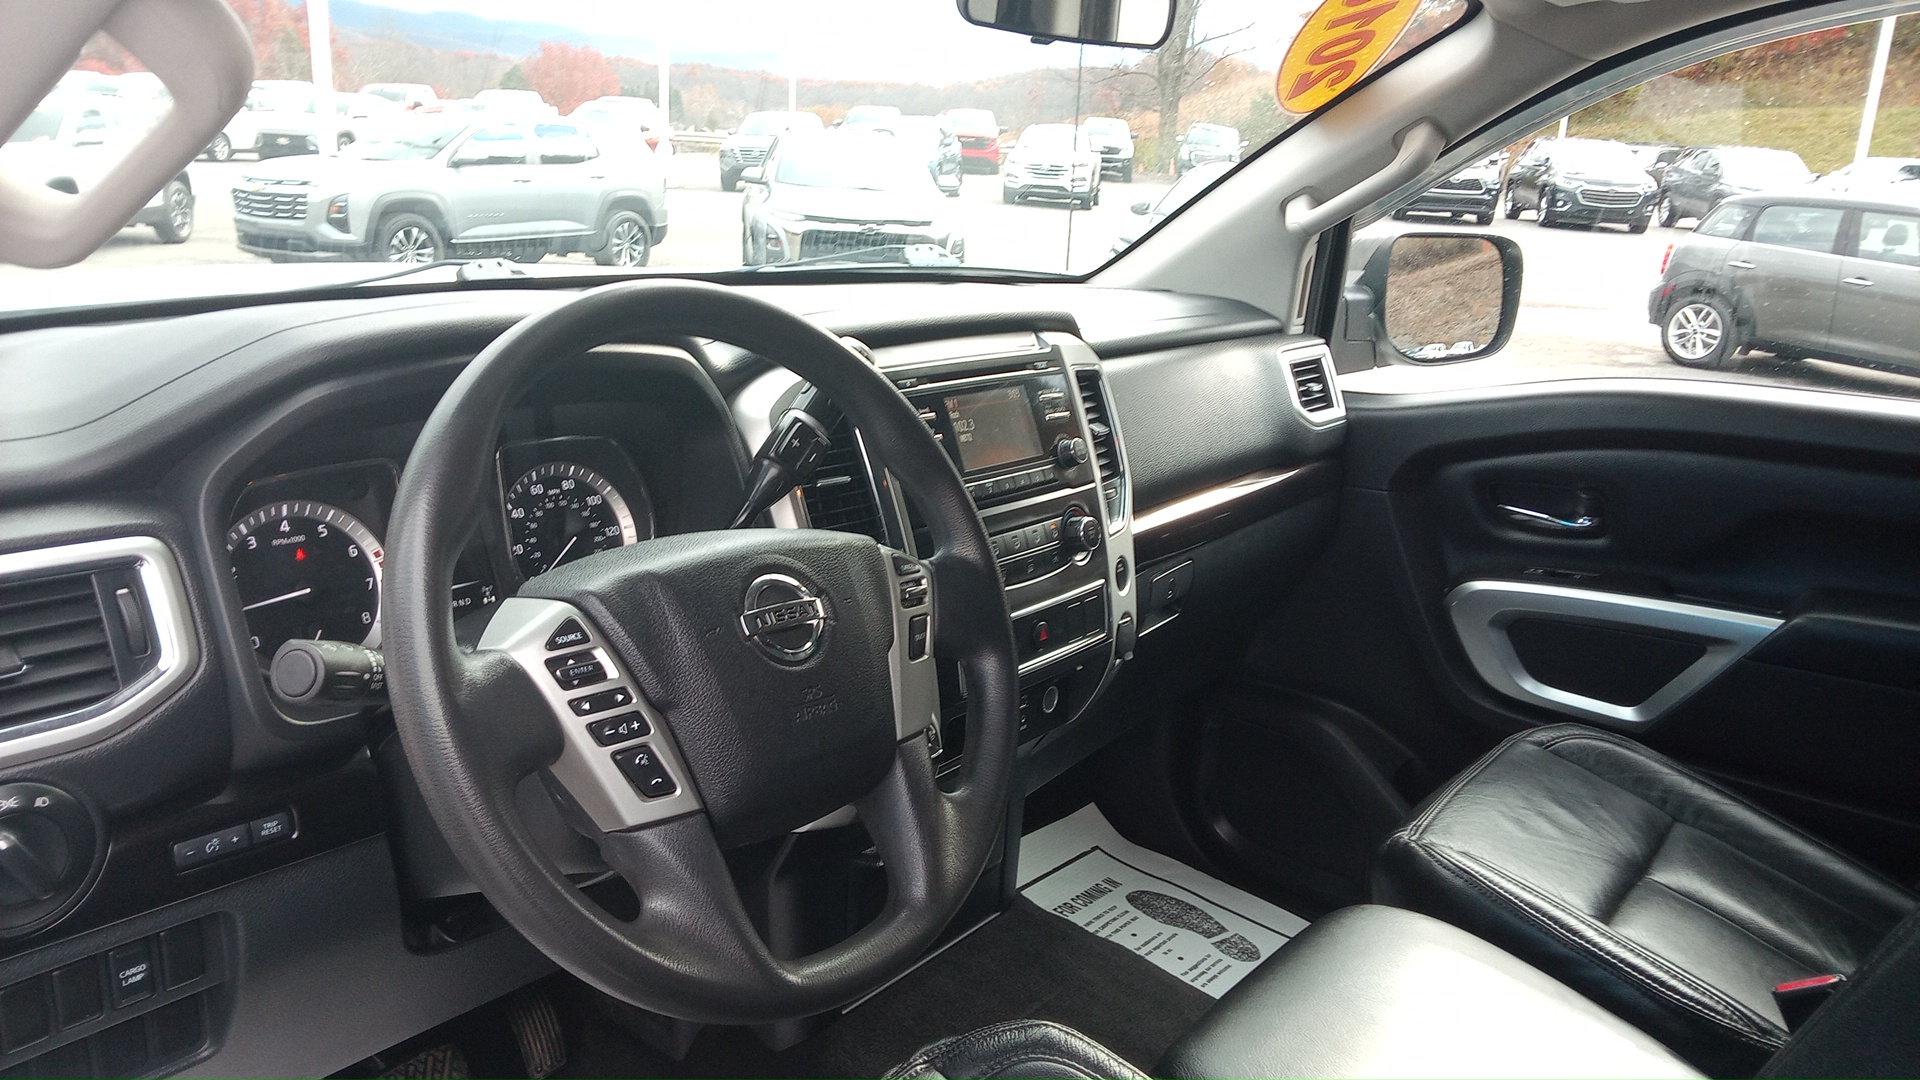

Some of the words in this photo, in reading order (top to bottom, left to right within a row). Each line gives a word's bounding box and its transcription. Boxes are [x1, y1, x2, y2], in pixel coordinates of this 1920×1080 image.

[530, 484, 544, 496] 60
[561, 479, 575, 491] 80
[586, 495, 603, 506] 100
[511, 508, 525, 519] 40
[280, 519, 290, 533] 4
[317, 524, 329, 538] 5
[604, 526, 620, 538] 120
[247, 536, 257, 549] 3
[348, 544, 358, 558] 6
[365, 577, 374, 590] 7
[361, 611, 372, 625] 8
[755, 601, 820, 629] NISSAN
[555, 631, 583, 645] SOURCE
[569, 665, 594, 676] ENTER
[261, 825, 283, 836] RESET
[263, 820, 279, 829] TRIP
[1052, 902, 1082, 917] FOR
[1070, 883, 1114, 907] COMING
[1101, 876, 1123, 889] IN
[119, 964, 147, 979] CARGO
[122, 973, 145, 986] LAMP
